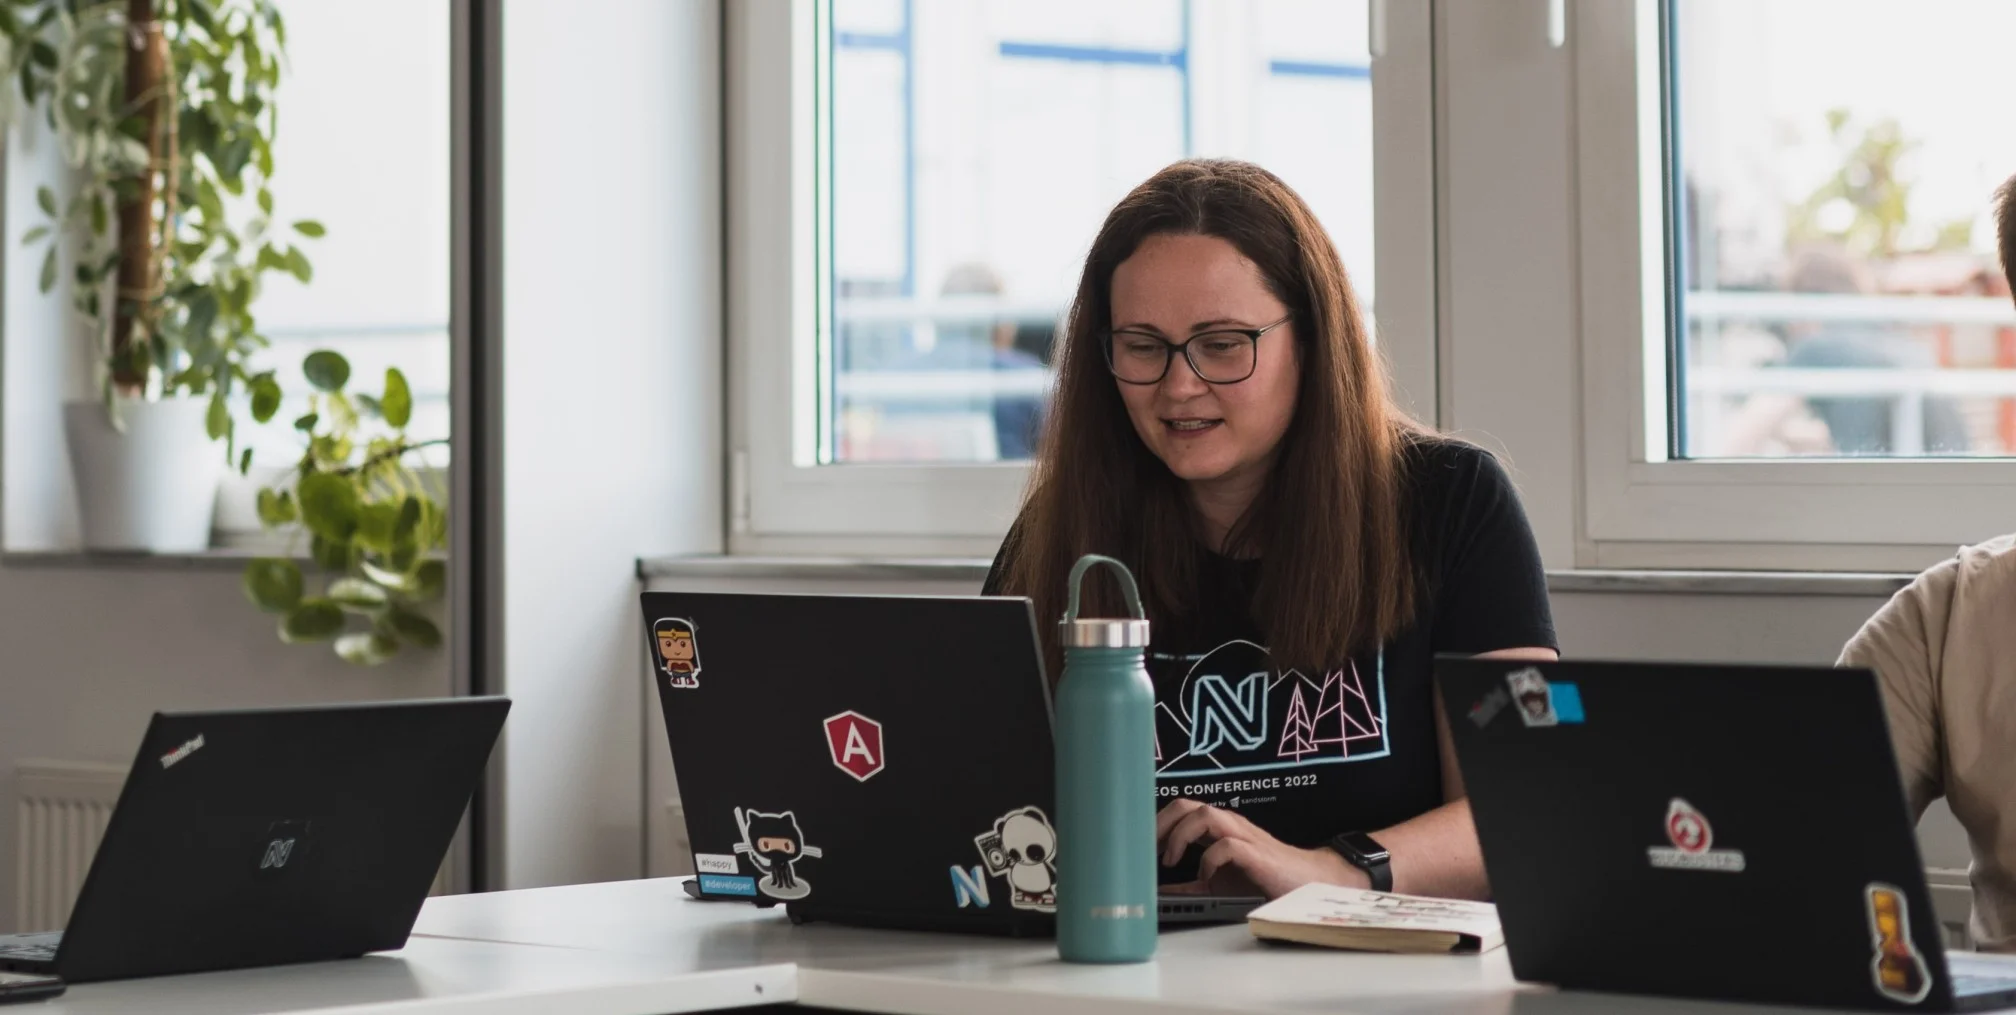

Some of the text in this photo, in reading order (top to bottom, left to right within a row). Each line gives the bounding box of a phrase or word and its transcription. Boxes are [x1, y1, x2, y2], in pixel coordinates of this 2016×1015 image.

[160, 733, 205, 769] ThinkPad
[842, 721, 876, 765] A
[1184, 778, 1280, 795] CONFERENCE
[1284, 774, 1318, 787] 2022
[1241, 796, 1278, 805] sandstorm
[701, 859, 732, 870] #happy
[704, 879, 752, 891] #developer
[950, 865, 990, 909] N
